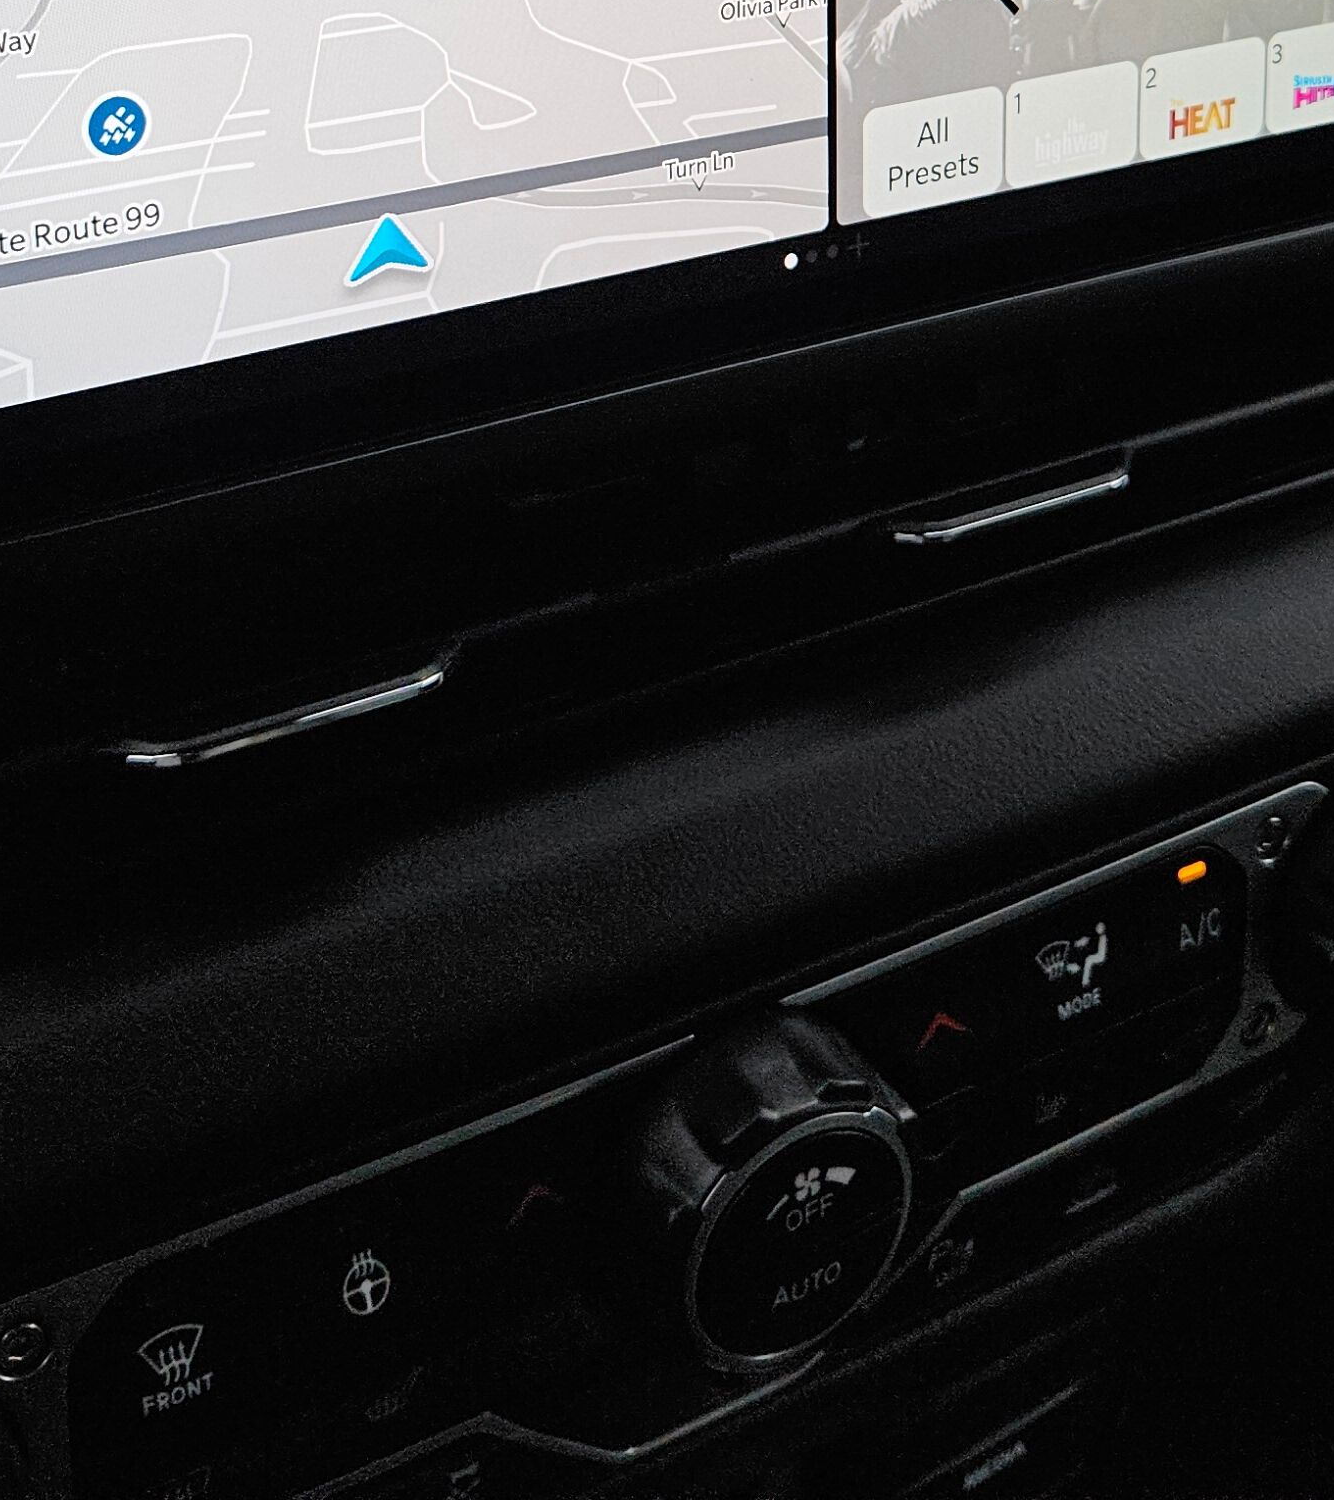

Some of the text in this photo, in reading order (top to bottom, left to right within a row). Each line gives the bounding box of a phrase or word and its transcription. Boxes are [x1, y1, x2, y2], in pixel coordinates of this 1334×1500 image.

[1272, 44, 1283, 64] 3
[1145, 68, 1157, 90] 2
[1013, 92, 1022, 115] 1
[1168, 97, 1236, 141] HEAT
[916, 117, 950, 148] All
[666, 153, 734, 179] Turn Ln
[888, 153, 979, 191] Presets
[35, 216, 118, 248] Route
[126, 203, 160, 230] 99
[1180, 908, 1221, 951] A/C
[785, 1193, 834, 1231] OFF
[772, 1261, 841, 1309] AUTO
[143, 1372, 214, 1416] FRONT
